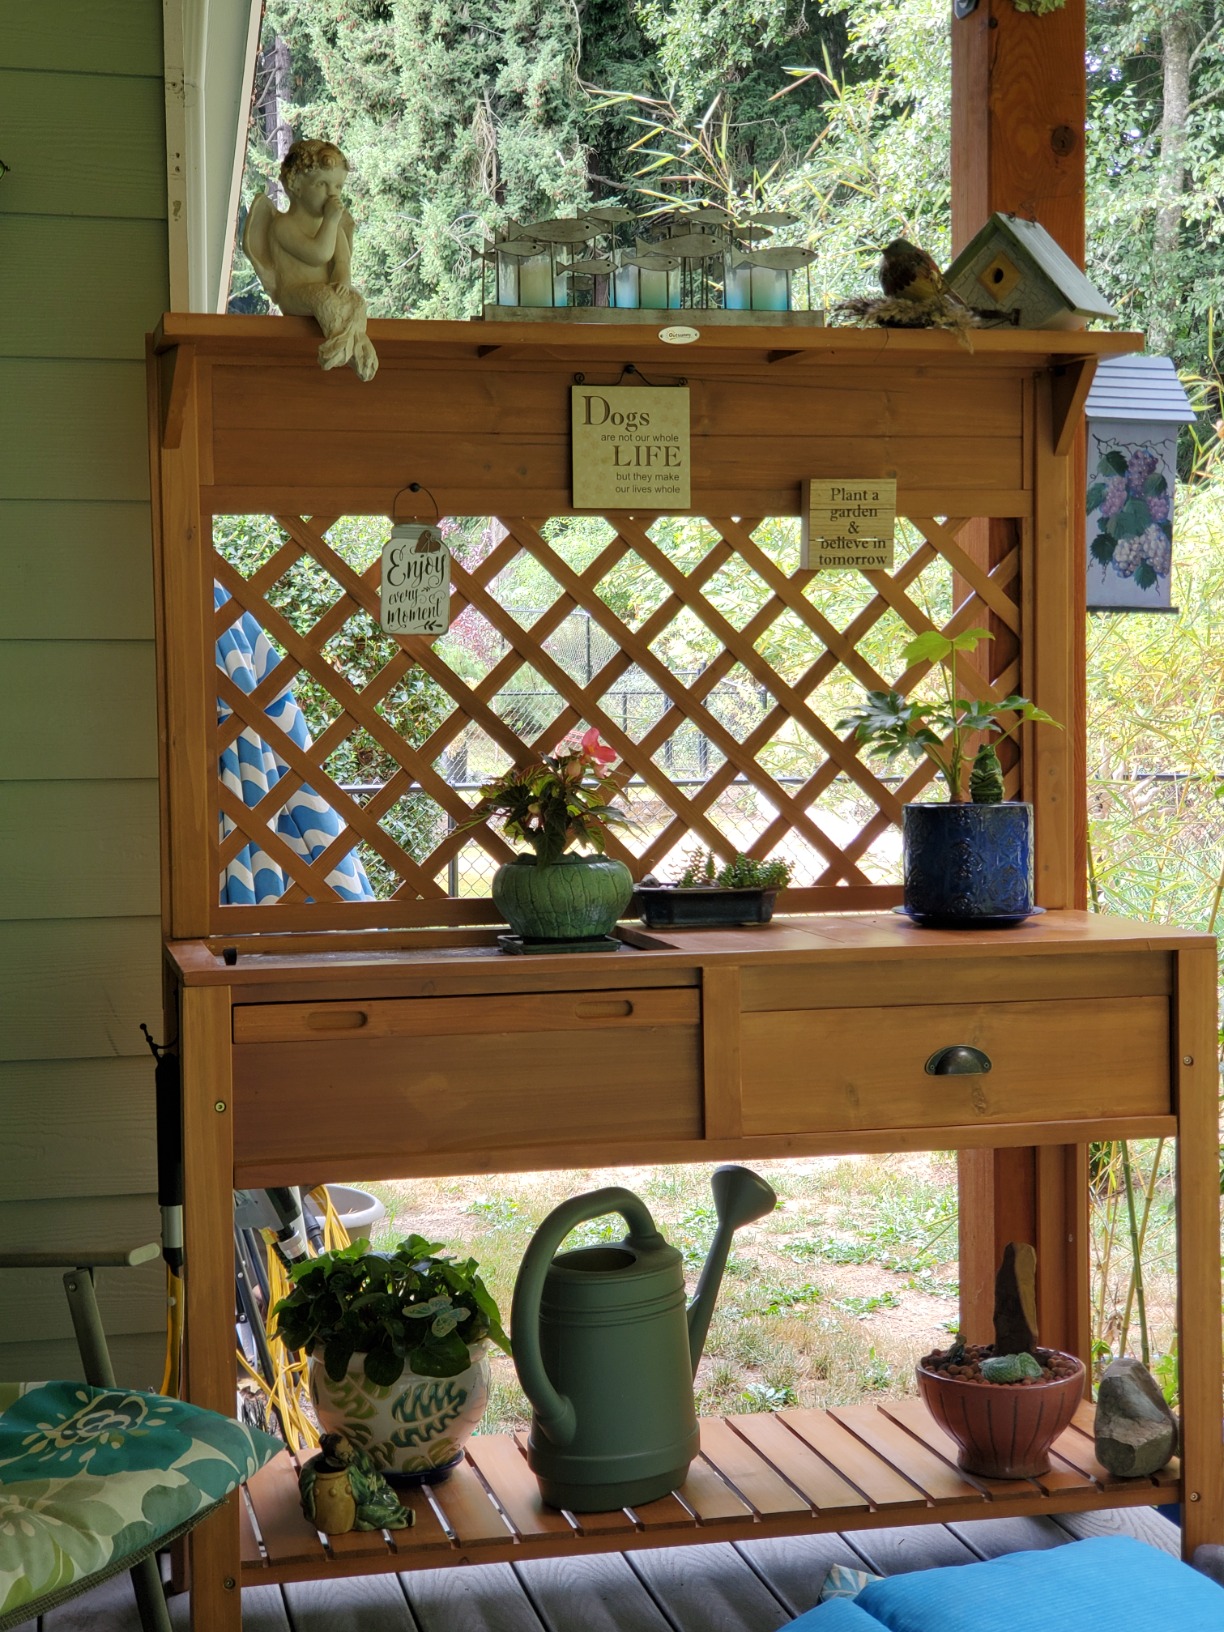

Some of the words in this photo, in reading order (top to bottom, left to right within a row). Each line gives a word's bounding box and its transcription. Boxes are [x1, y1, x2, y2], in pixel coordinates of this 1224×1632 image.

[582, 395, 650, 433] Dogs
[601, 434, 616, 442] are
[618, 433, 633, 442] not
[635, 434, 651, 442] our
[652, 433, 679, 442] whole
[613, 445, 682, 467] LIFE
[616, 472, 630, 481] but
[633, 472, 652, 483] they
[654, 472, 680, 481] make
[615, 485, 630, 493] our
[632, 485, 652, 493] lives
[654, 485, 680, 493] whole
[831, 488, 868, 501] Plant
[872, 491, 879, 501] a
[830, 504, 878, 522] garden
[847, 521, 860, 534] &
[820, 536, 869, 549] believe
[873, 536, 886, 549] in
[387, 545, 447, 588] Enjoy
[819, 555, 888, 566] tomorrow
[388, 588, 427, 608] every
